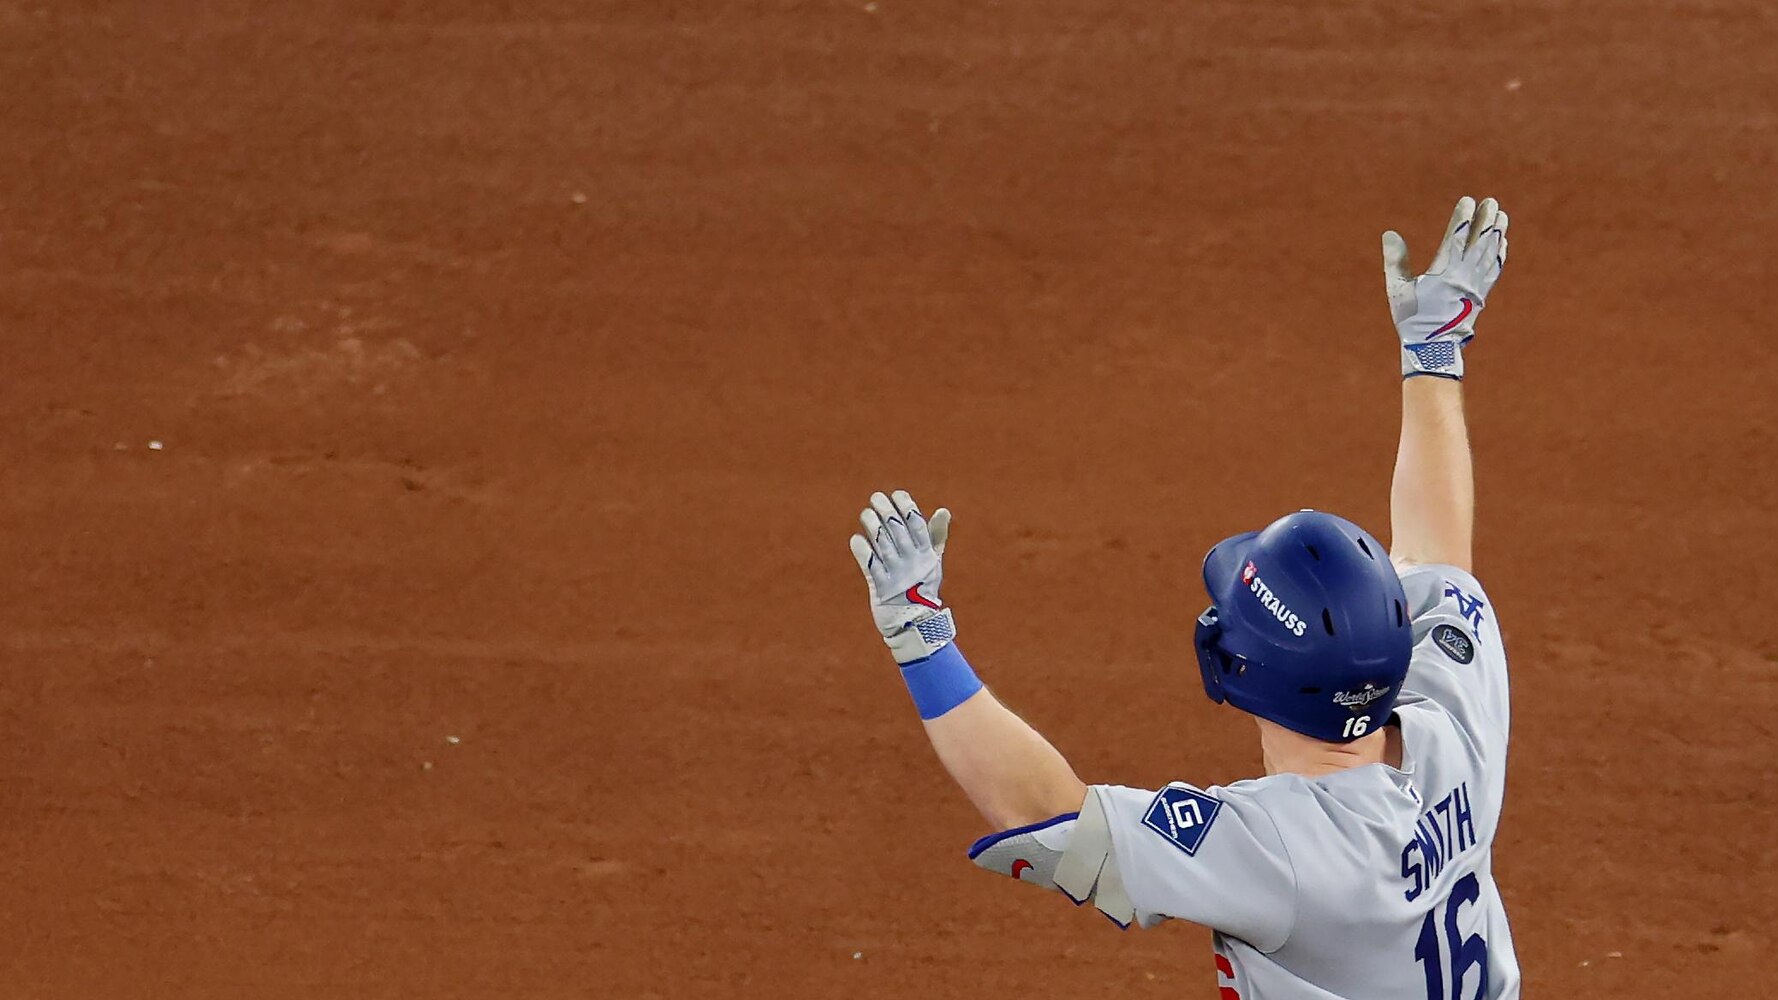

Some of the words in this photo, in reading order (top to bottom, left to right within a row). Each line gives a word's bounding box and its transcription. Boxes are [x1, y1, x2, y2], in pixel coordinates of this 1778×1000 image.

[1250, 576, 1307, 636] STRAUSS
[1342, 715, 1371, 738] 16
[1401, 781, 1477, 902] SMITH
